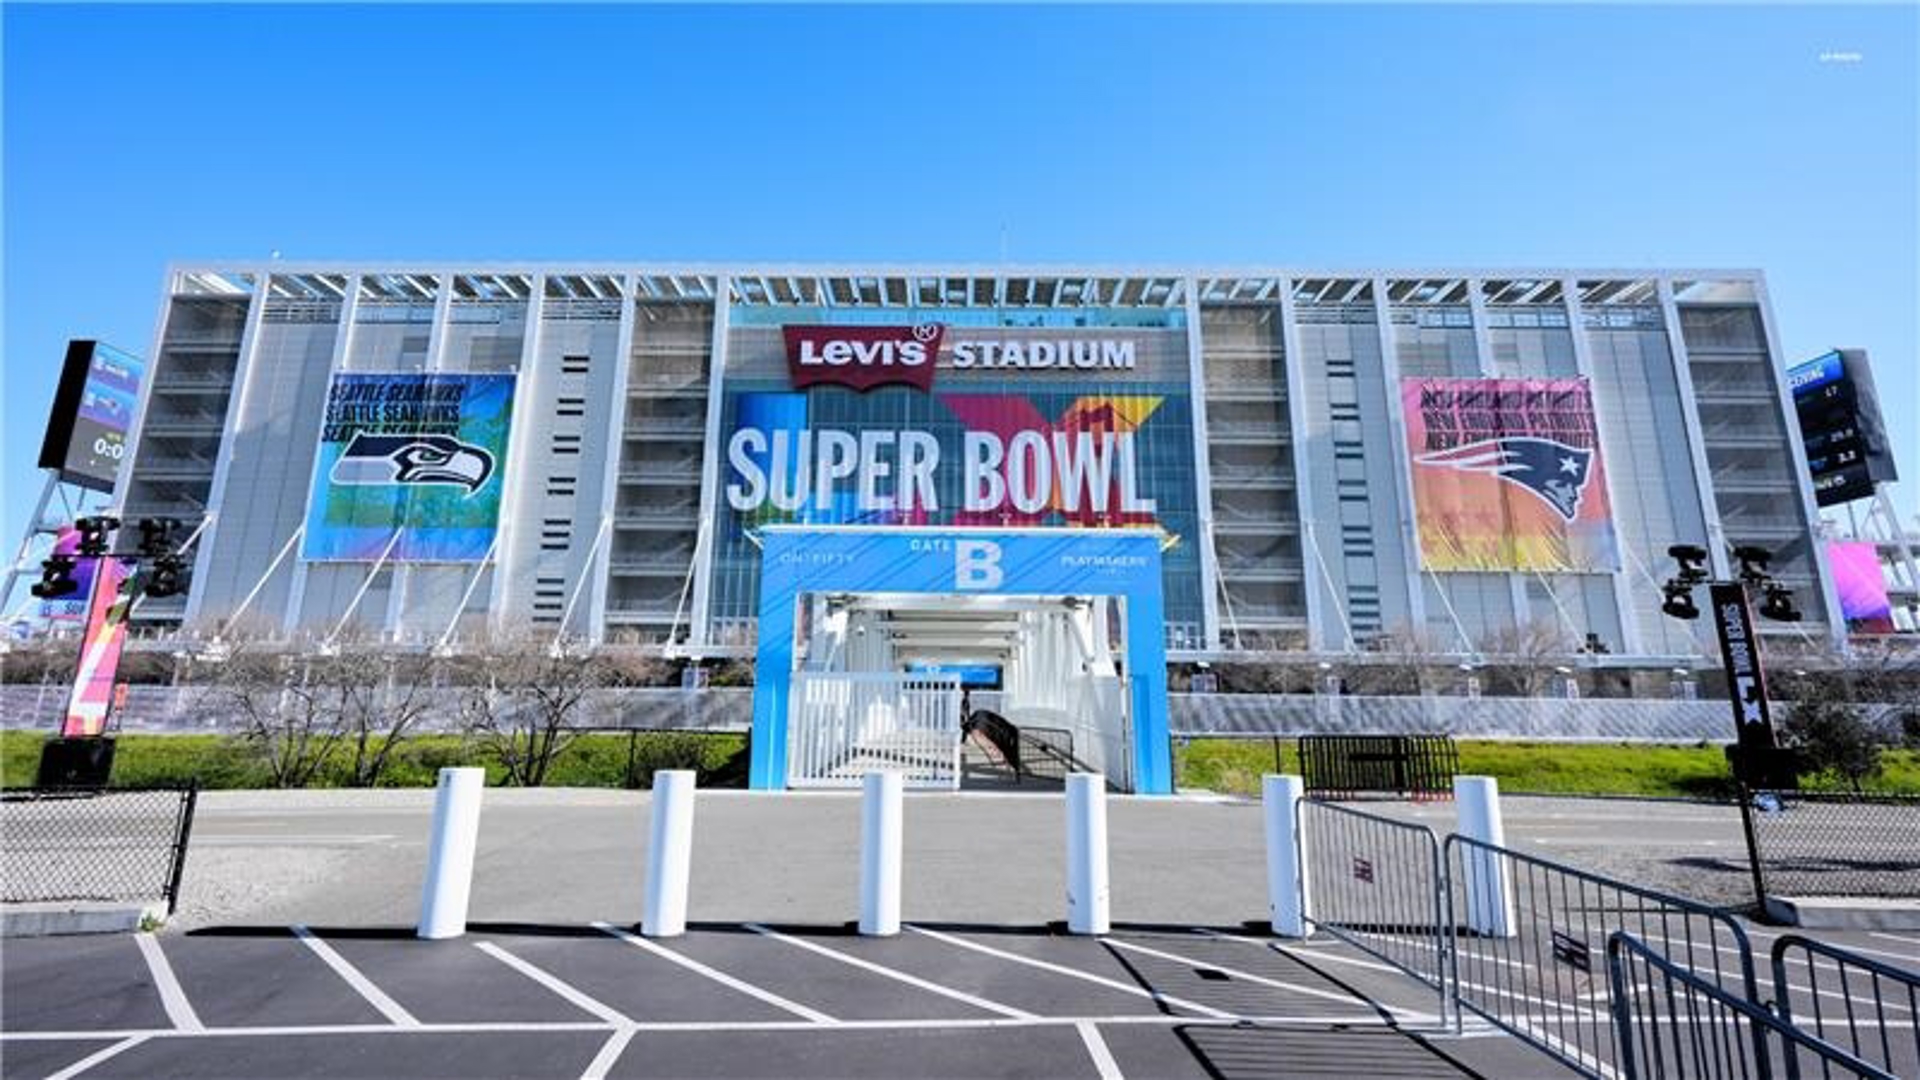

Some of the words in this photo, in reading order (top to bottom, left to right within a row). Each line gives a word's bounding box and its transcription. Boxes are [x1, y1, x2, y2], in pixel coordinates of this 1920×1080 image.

[953, 339, 1136, 369] STADIUM
[329, 384, 385, 401] SEATTLE
[386, 384, 466, 401] SEAHAWKS
[326, 404, 381, 423] SEATTLE
[383, 404, 460, 423] SEAHAWKS
[727, 427, 939, 513] SUPER
[963, 430, 1157, 514] BOWL
[910, 538, 951, 551] GATE
[955, 540, 1004, 590] B
[1722, 603, 1746, 640] SUPER
[1729, 641, 1753, 675] BOWL
